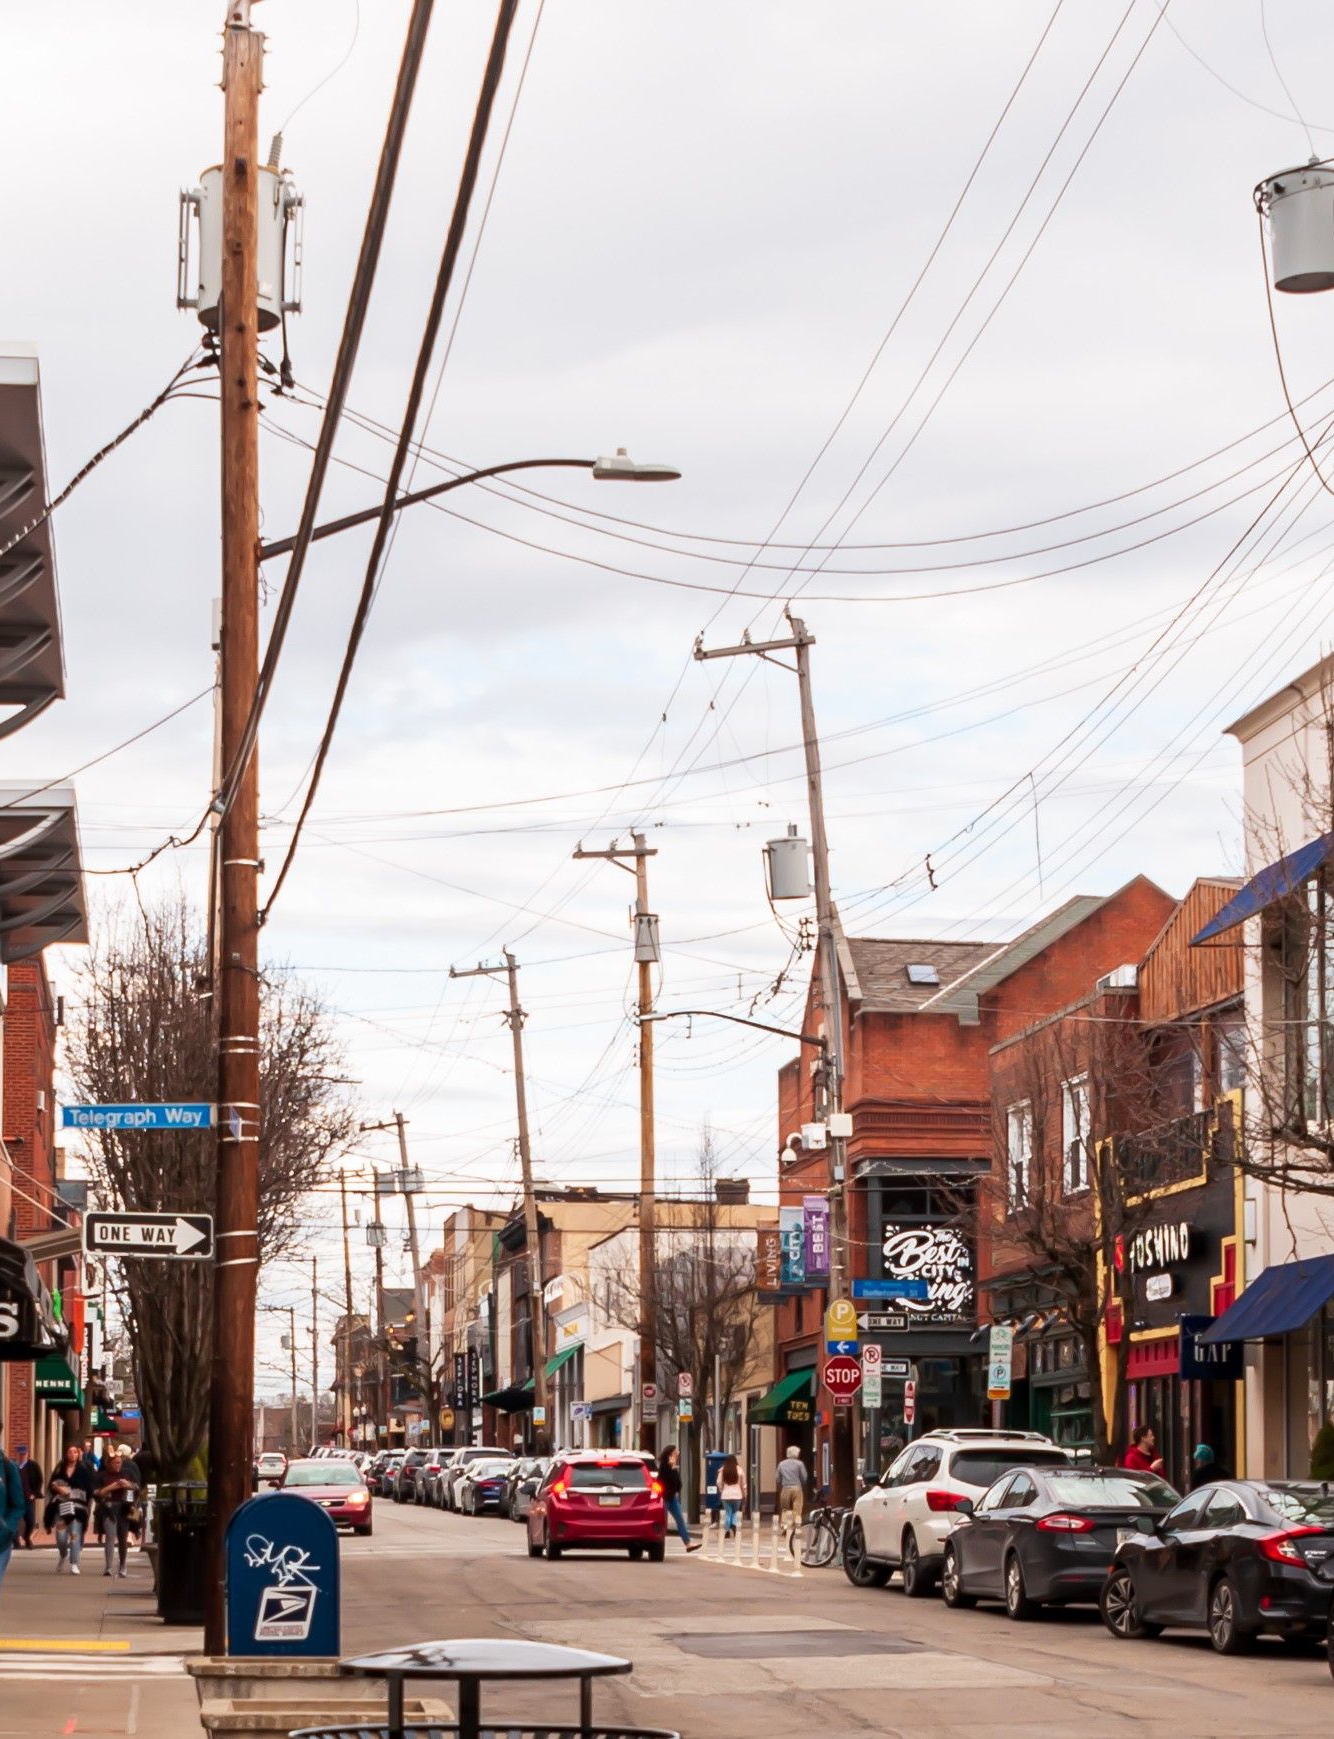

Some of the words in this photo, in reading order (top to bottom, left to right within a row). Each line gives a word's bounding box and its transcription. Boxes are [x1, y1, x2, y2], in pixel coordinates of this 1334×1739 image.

[70, 1108, 157, 1128] Telegraph
[165, 1108, 203, 1126] Way
[100, 1225, 130, 1242] ONE
[141, 1227, 176, 1244] WAY
[812, 1214, 824, 1253] BEST
[883, 1230, 963, 1273] Best
[766, 1238, 777, 1286] LIVING
[921, 1264, 956, 1278] CITY
[868, 1317, 882, 1326] ONE
[886, 1317, 901, 1326] WAY
[35, 1380, 71, 1388] HENNE
[827, 1368, 860, 1384] STOP
